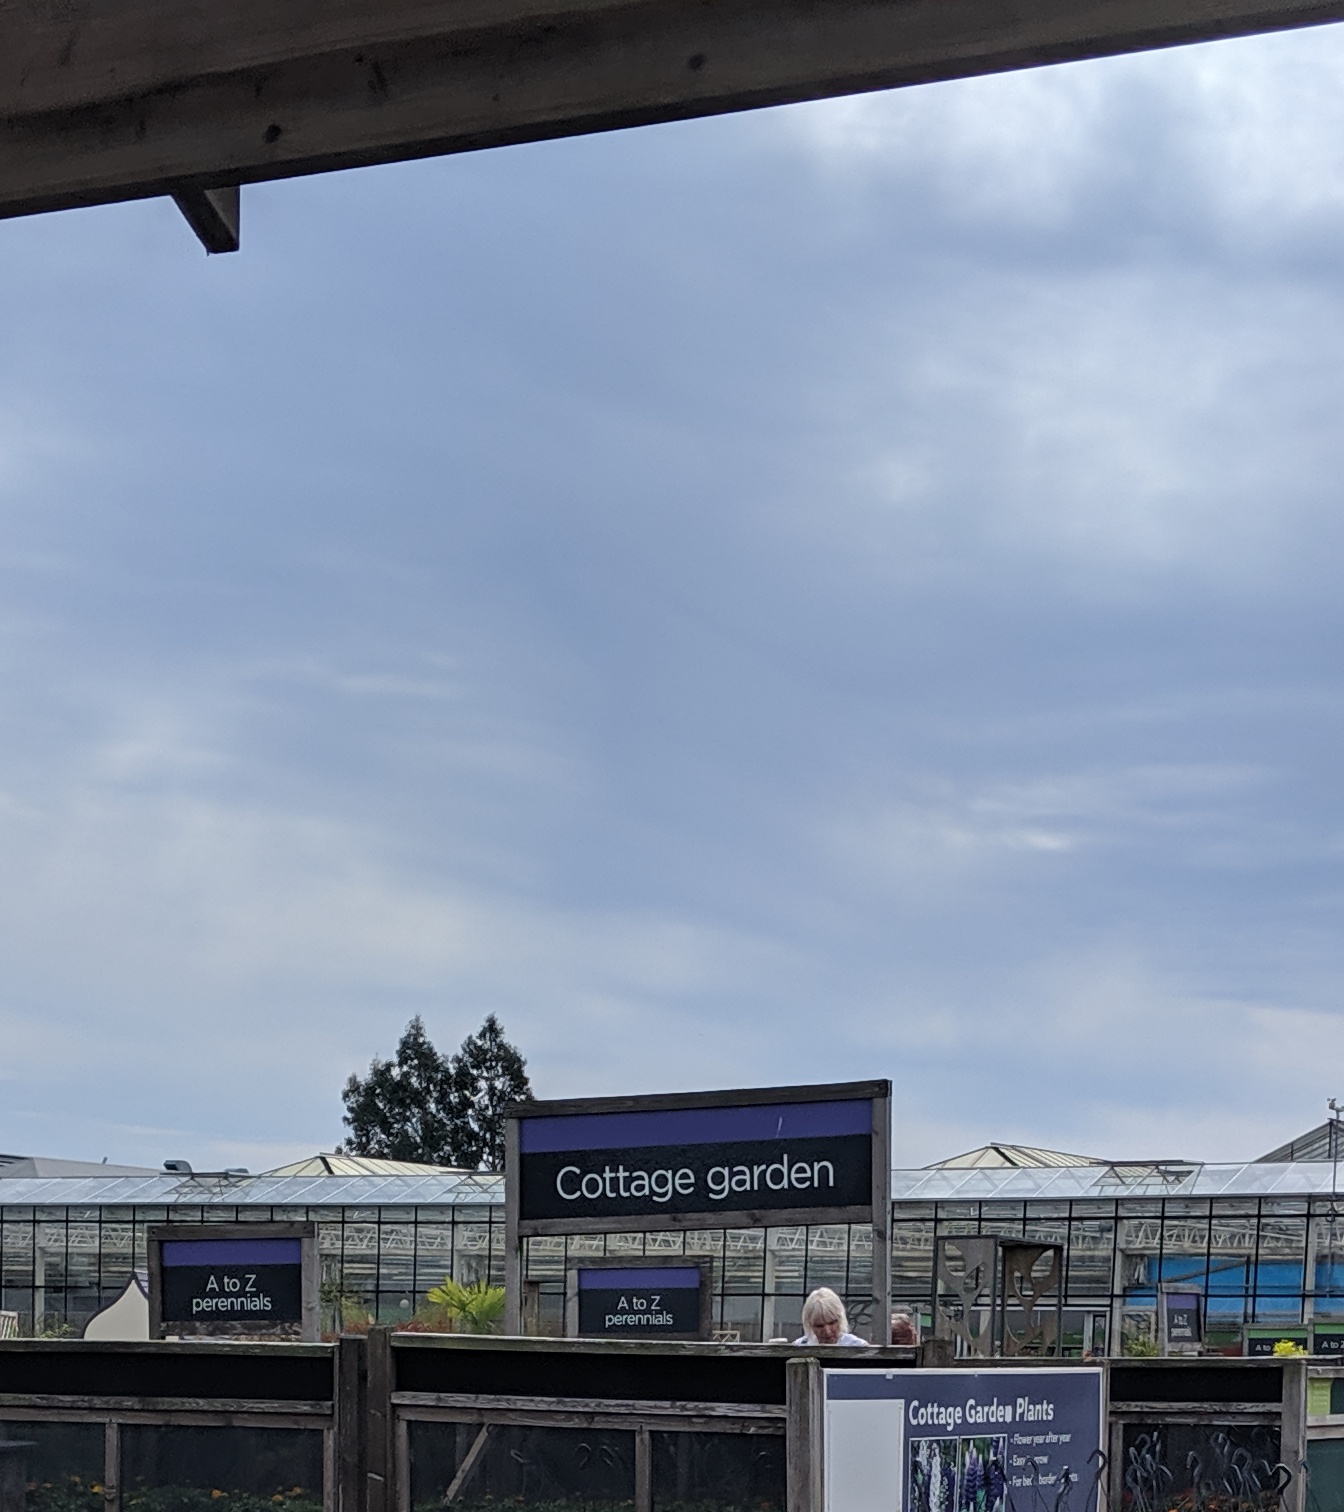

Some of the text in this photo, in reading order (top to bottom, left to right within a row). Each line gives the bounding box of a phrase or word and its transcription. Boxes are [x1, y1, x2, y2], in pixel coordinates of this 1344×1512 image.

[556, 1154, 834, 1202] Cottage garden
[206, 1274, 257, 1292] A to Z
[192, 1293, 272, 1314] perennials
[617, 1295, 661, 1310] A to Z
[605, 1311, 673, 1328] perennials
[1321, 1340, 1330, 1349] A
[1329, 1340, 1339, 1349] to
[908, 1396, 1055, 1431] Cottage Garden Plants
